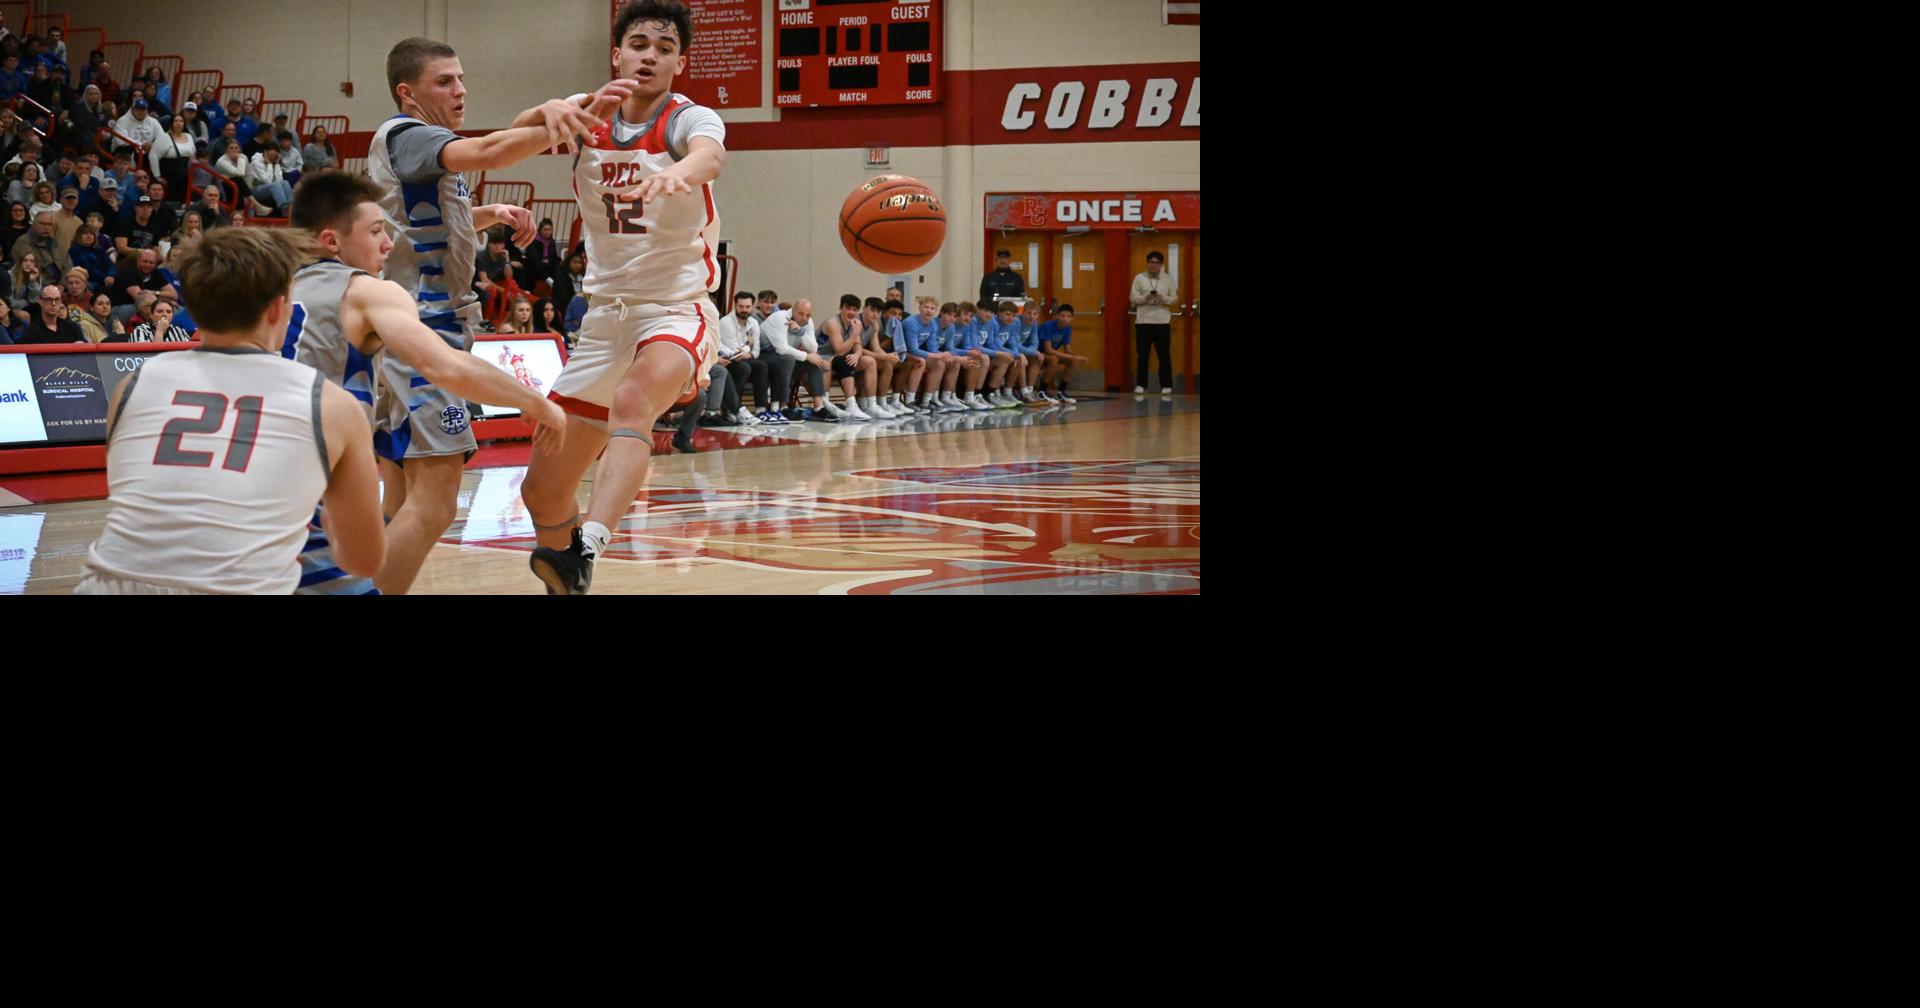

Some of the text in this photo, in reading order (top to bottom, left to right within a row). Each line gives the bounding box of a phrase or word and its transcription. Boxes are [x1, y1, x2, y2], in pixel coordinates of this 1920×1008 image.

[891, 5, 930, 20] GUEST
[781, 12, 813, 25] HOME
[839, 16, 868, 26] PERIOD
[828, 56, 880, 66] PLAYER FOUL
[906, 53, 932, 63] FOULS
[777, 59, 802, 69] FOULS
[777, 94, 802, 104] SCORE
[839, 92, 867, 102] MATCH
[906, 90, 932, 100] SCORE
[599, 162, 642, 187] RCC
[602, 193, 647, 234] 12
[1056, 199, 1176, 222] ONCE A
[0, 389, 29, 403] ank
[152, 389, 264, 473] 21
